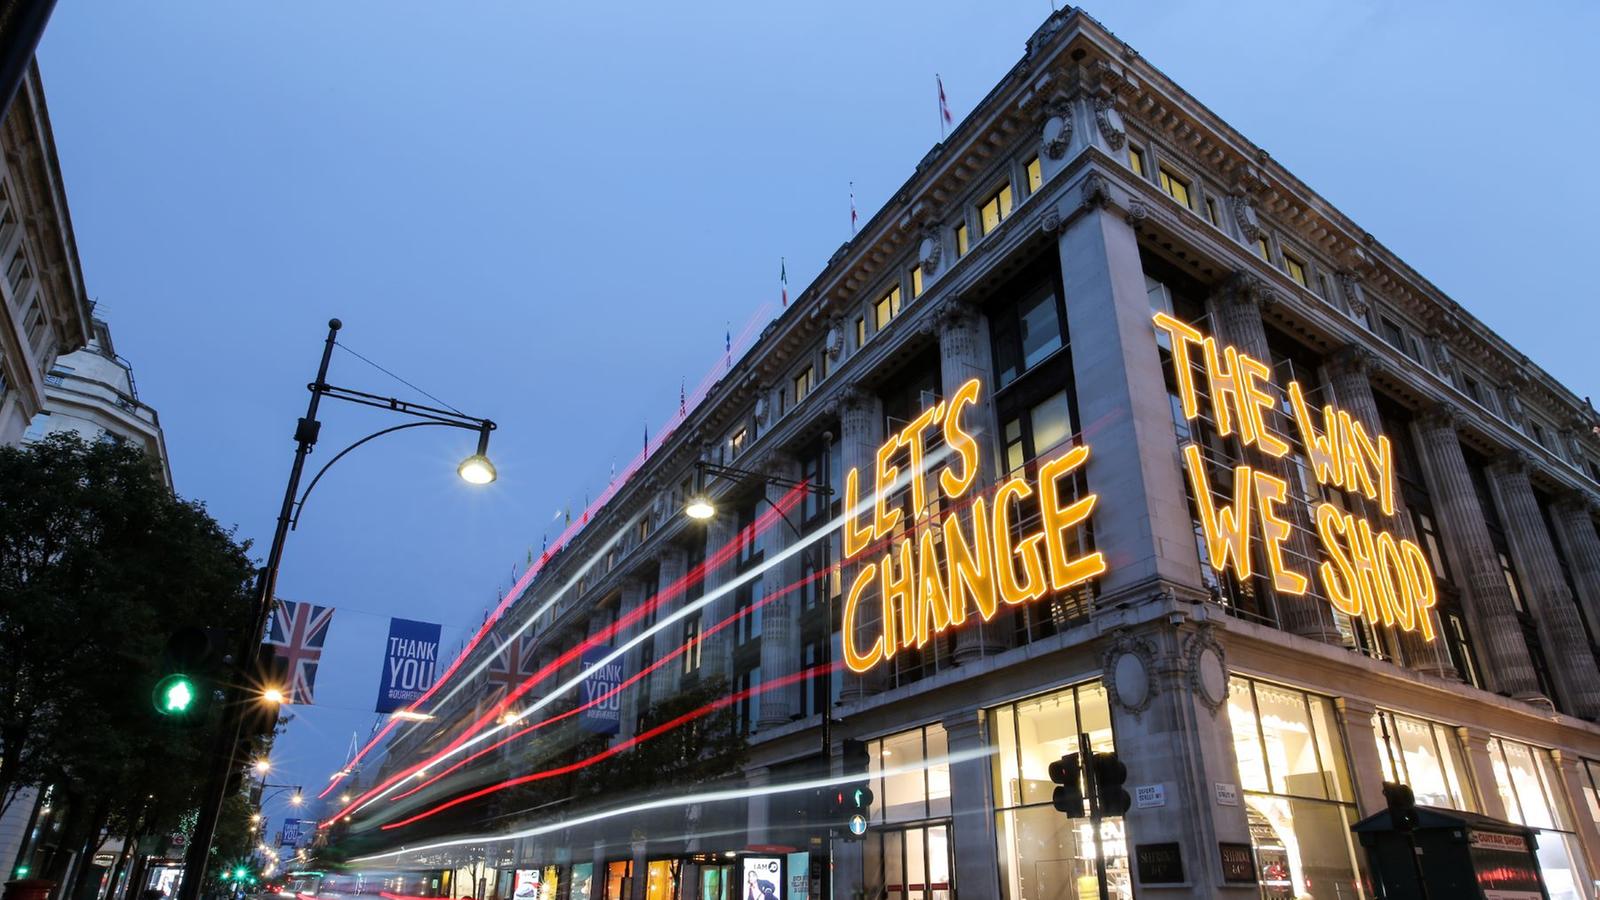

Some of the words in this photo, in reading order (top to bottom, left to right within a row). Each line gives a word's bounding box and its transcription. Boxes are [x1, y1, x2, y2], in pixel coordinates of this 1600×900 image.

[844, 378, 981, 559] LET'S
[1152, 312, 1290, 458] THE
[1288, 381, 1394, 516] WAY
[842, 445, 1106, 673] CHANGE
[1184, 444, 1308, 595] WE
[1316, 503, 1436, 642] SHOP
[389, 657, 434, 692] YOU
[390, 637, 437, 661] THANK
[585, 680, 621, 710] YOU
